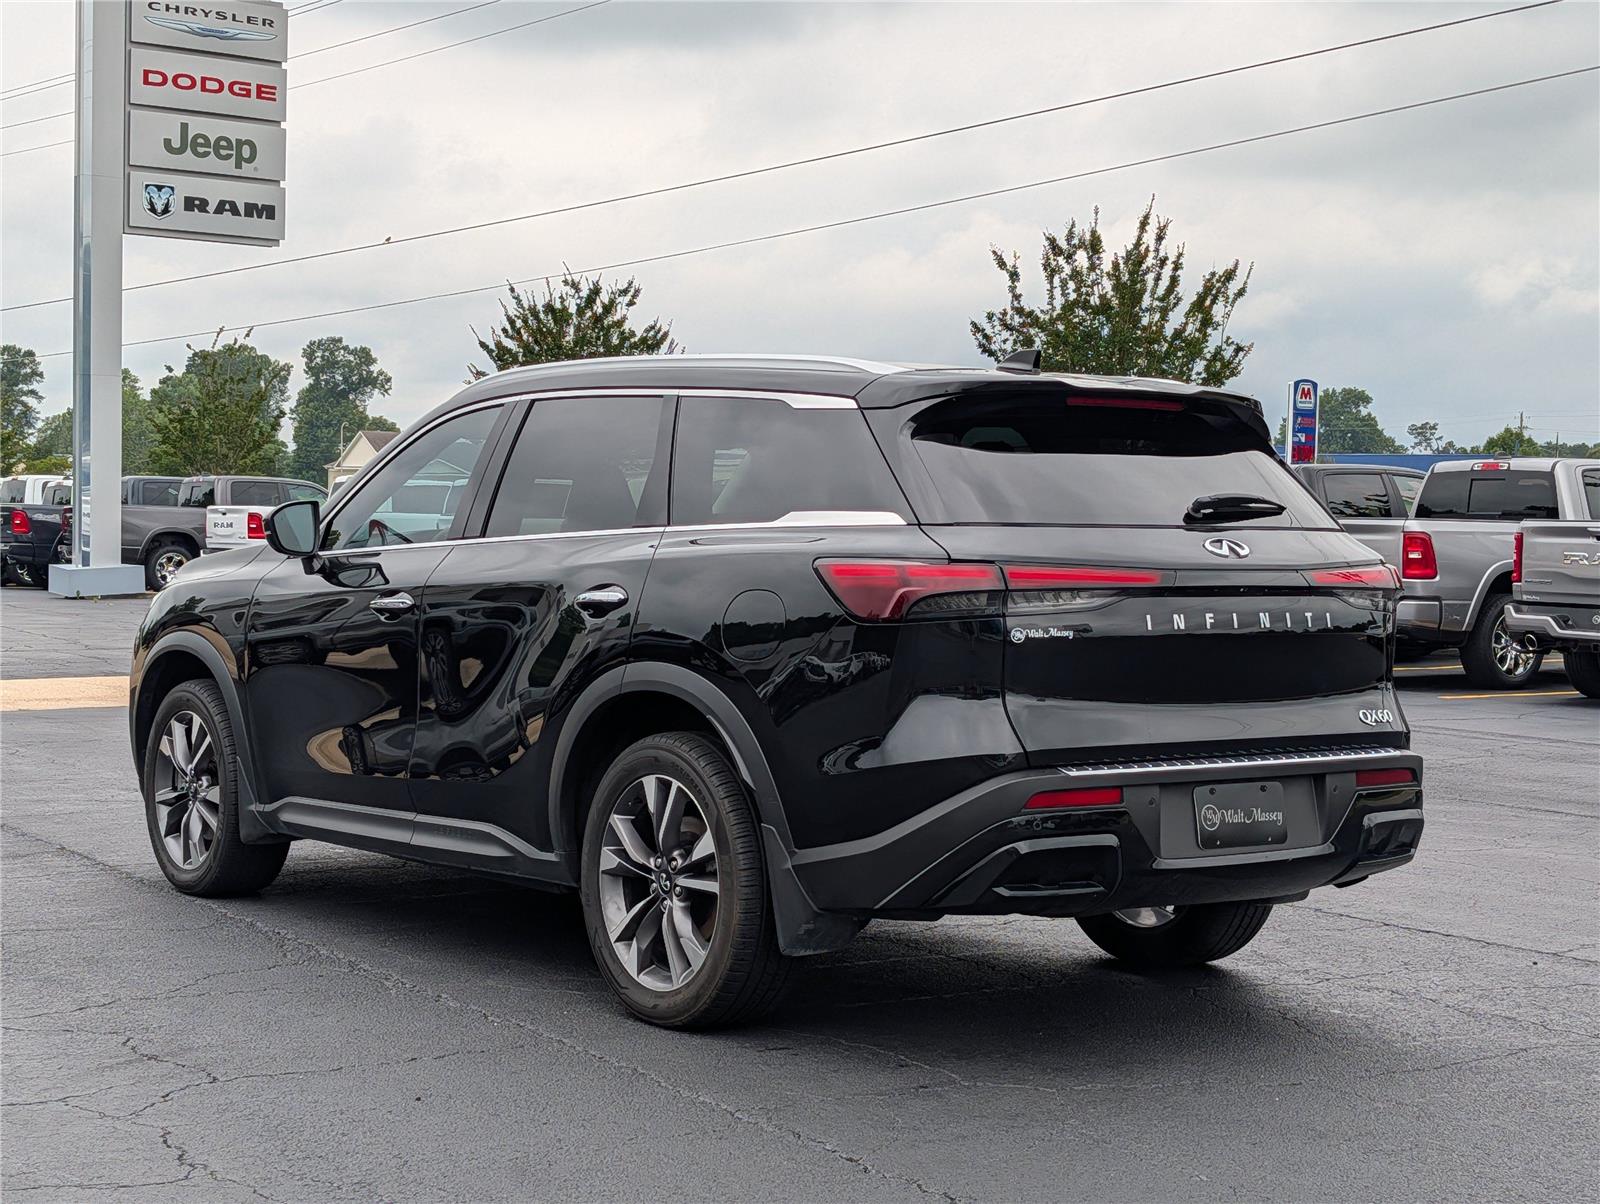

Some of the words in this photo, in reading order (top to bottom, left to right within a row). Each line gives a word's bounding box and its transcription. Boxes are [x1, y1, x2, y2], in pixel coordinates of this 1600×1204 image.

[147, 1, 275, 28] CHRYSLER
[142, 68, 277, 102] DODGE
[163, 122, 258, 169] Jeep
[183, 195, 276, 221] RAM
[213, 521, 234, 529] RAM
[1145, 612, 1332, 631] INFINITI
[1024, 628, 1044, 638] Walt
[1044, 627, 1074, 640] Massey
[1359, 709, 1394, 726] QX60
[1219, 809, 1245, 824] Walt
[1245, 807, 1283, 826] Massey
